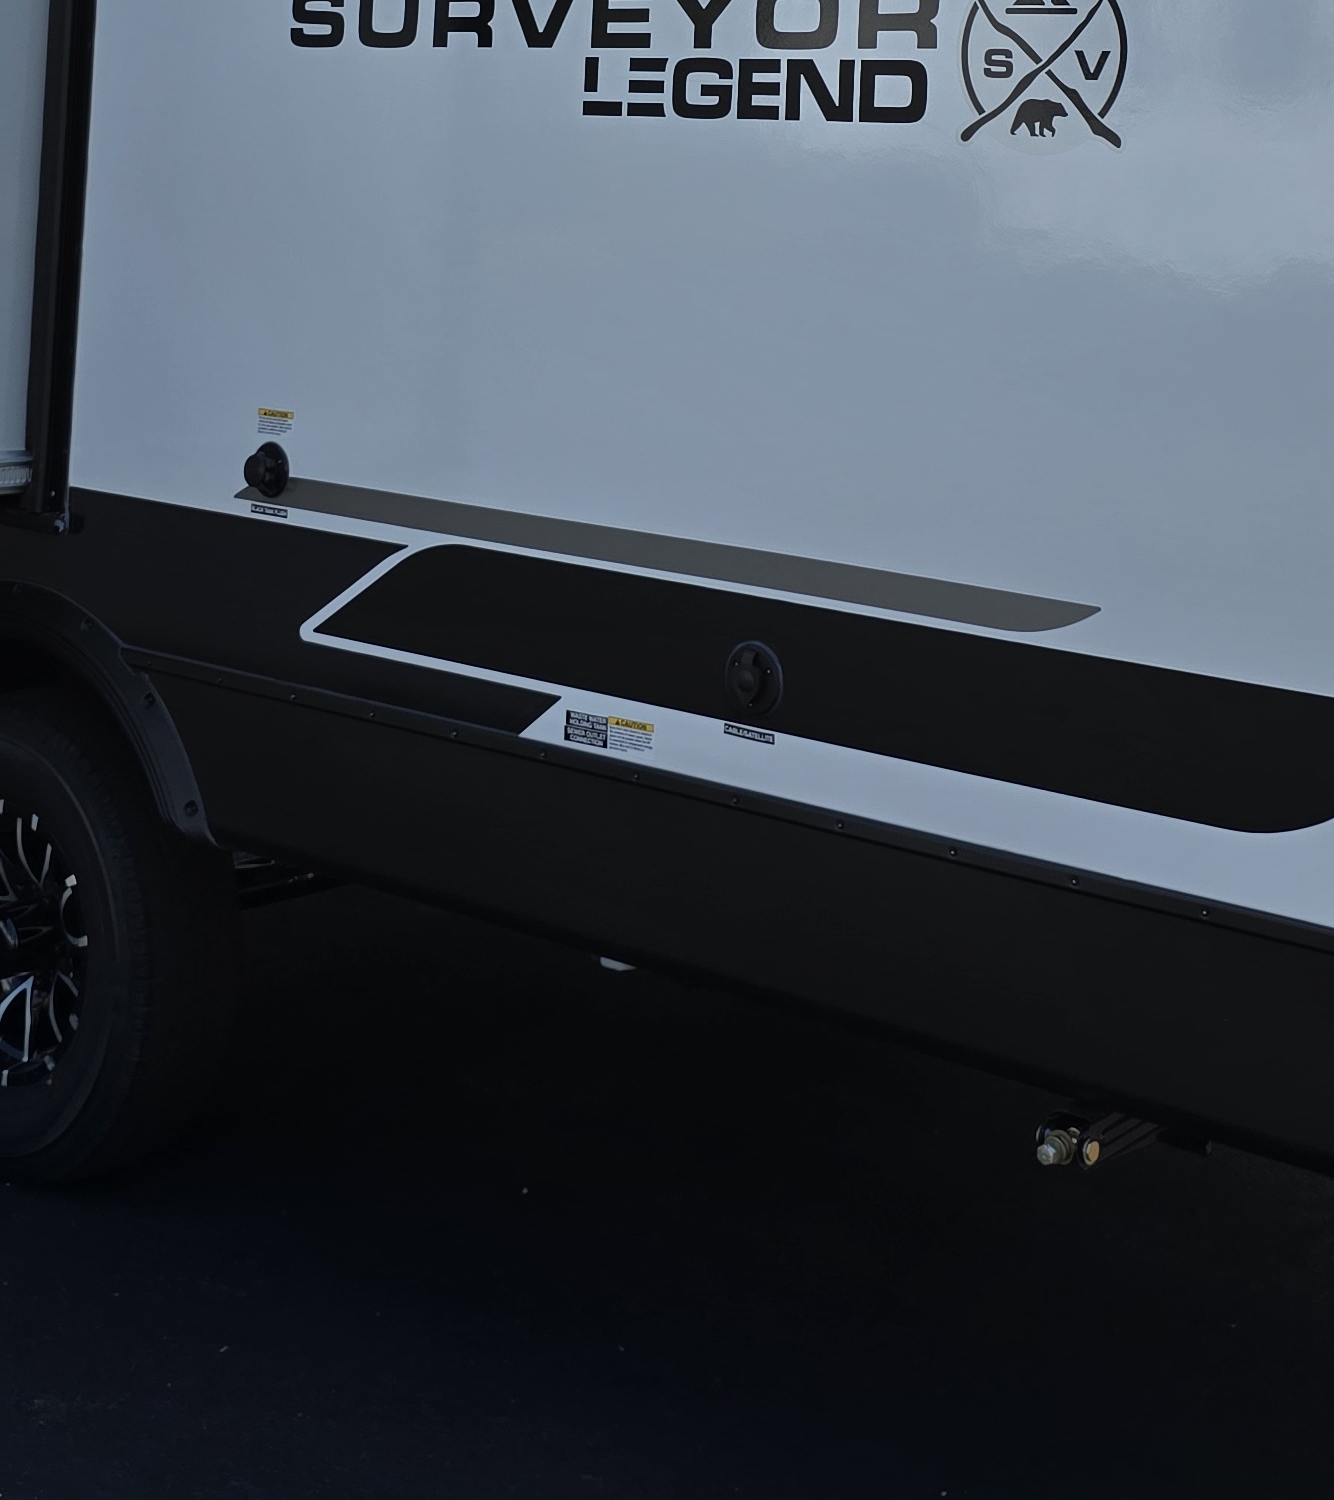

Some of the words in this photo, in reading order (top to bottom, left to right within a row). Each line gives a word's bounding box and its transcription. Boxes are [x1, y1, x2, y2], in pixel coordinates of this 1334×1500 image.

[983, 48, 1014, 79] S
[1074, 49, 1111, 81] V
[582, 56, 928, 124] LEGEND
